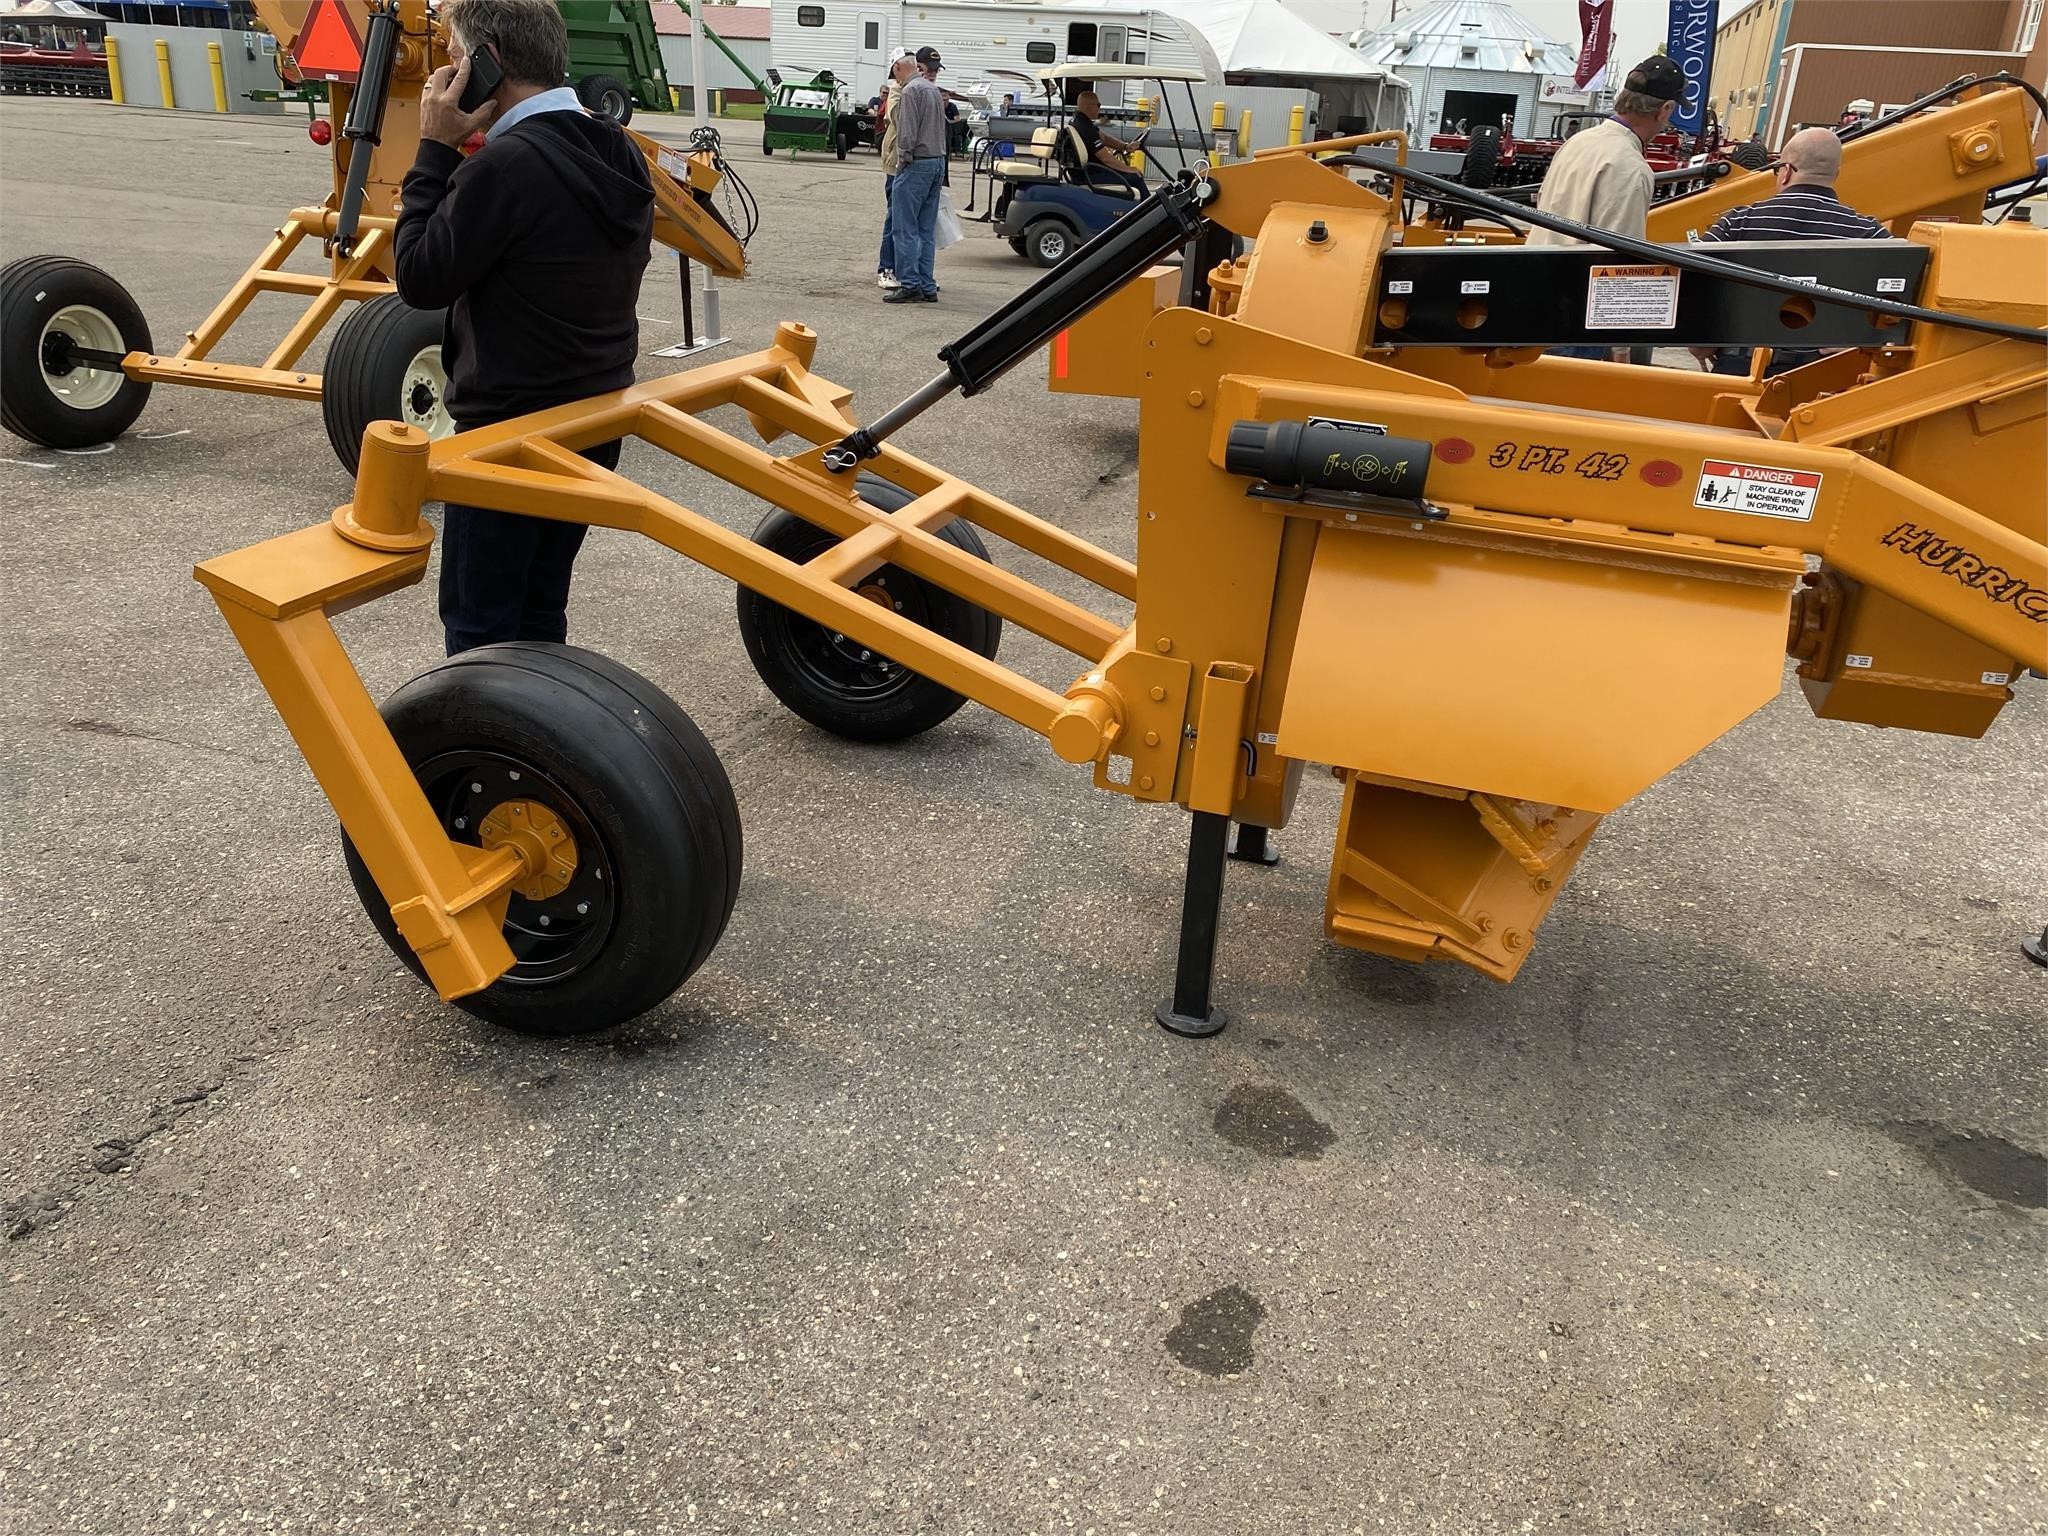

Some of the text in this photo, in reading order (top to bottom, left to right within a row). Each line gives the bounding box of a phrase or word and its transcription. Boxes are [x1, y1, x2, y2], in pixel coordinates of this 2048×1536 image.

[1671, 21, 1684, 53] Inc.
[1615, 268, 1655, 276] WARNING
[1489, 442, 1632, 481] 3 PT. 42
[1744, 469, 1794, 483] DANGER
[1768, 487, 1793, 495] CLEAR
[1746, 493, 1804, 506] MACHINE WHEN
[1756, 502, 1799, 513] OPERATION
[1880, 522, 2048, 623] HURRIC
